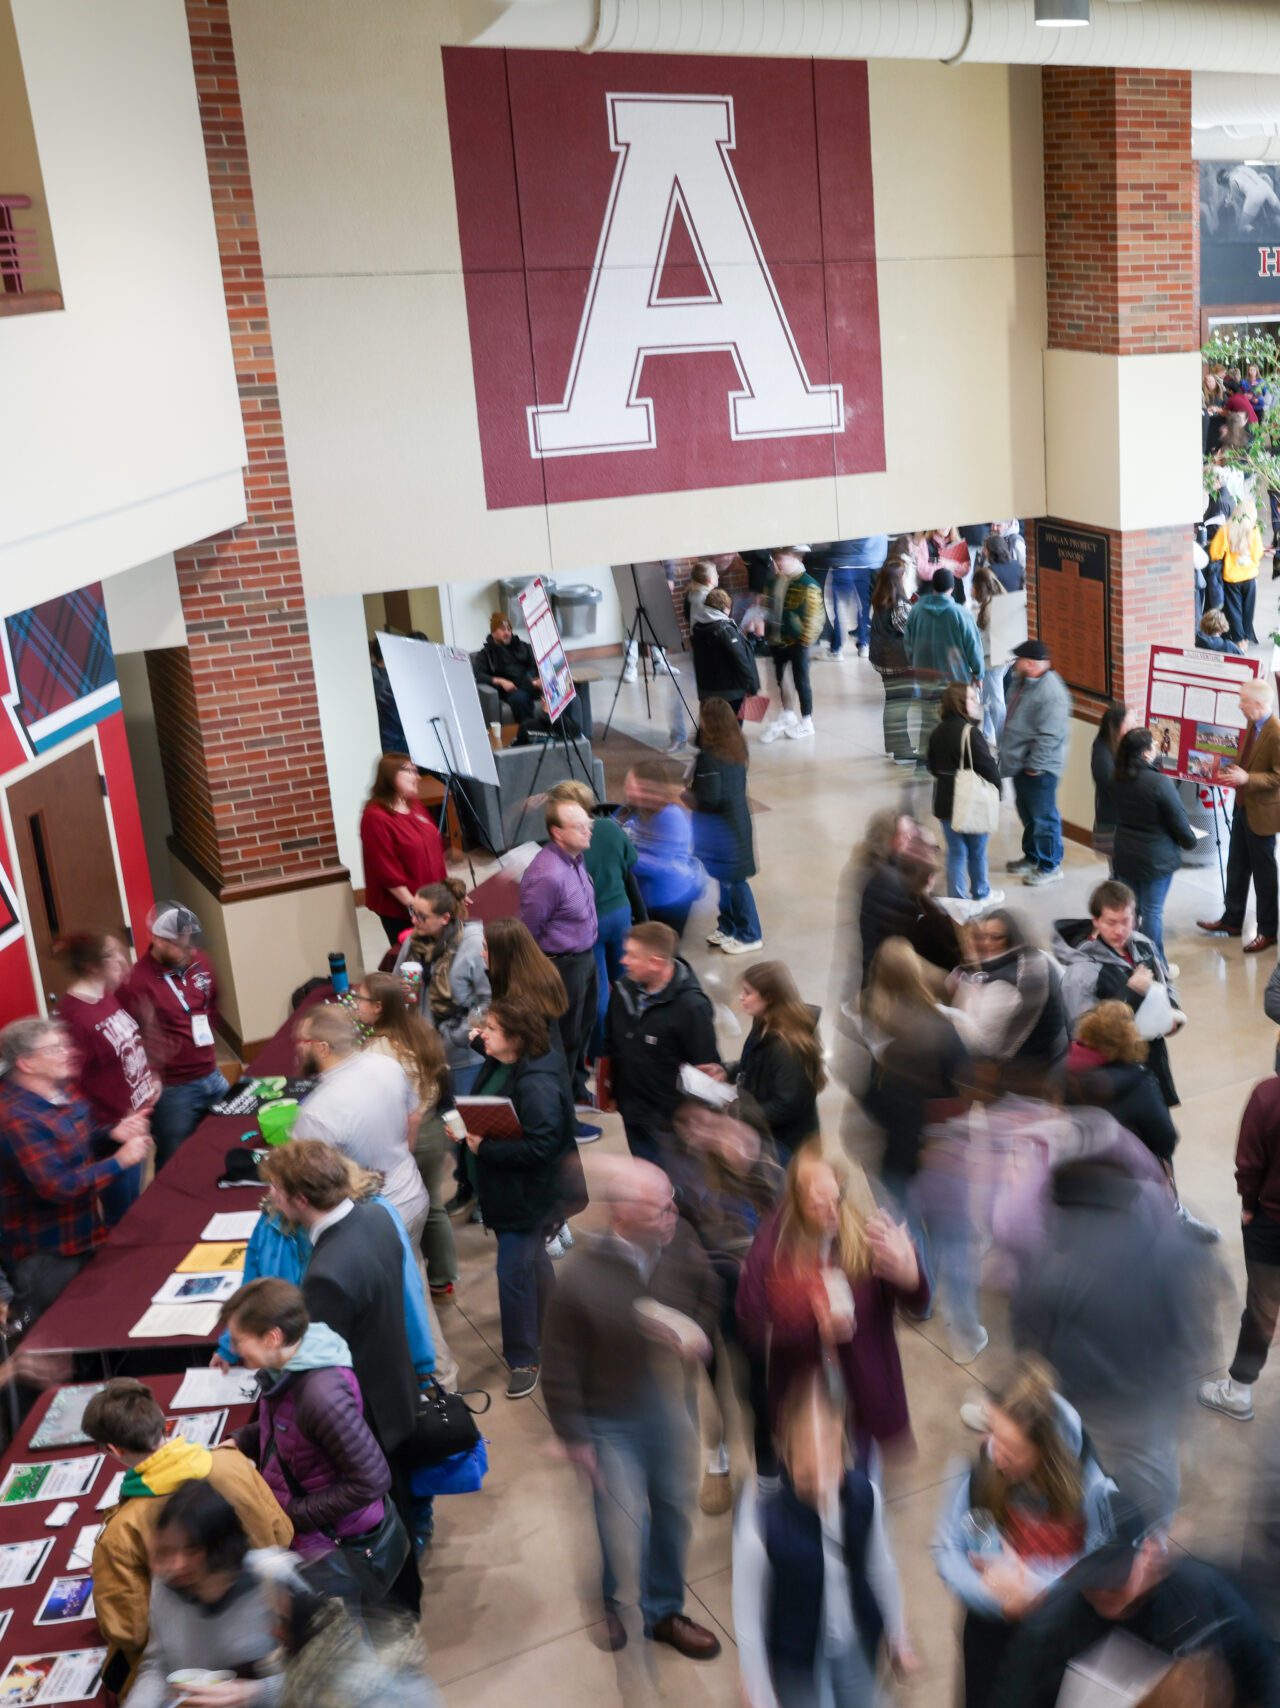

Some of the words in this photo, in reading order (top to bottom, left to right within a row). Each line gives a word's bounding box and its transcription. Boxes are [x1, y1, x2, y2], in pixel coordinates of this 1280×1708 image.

[526, 92, 845, 459] A
[1069, 537, 1098, 553] PROJECT
[1057, 548, 1086, 561] DONORS
